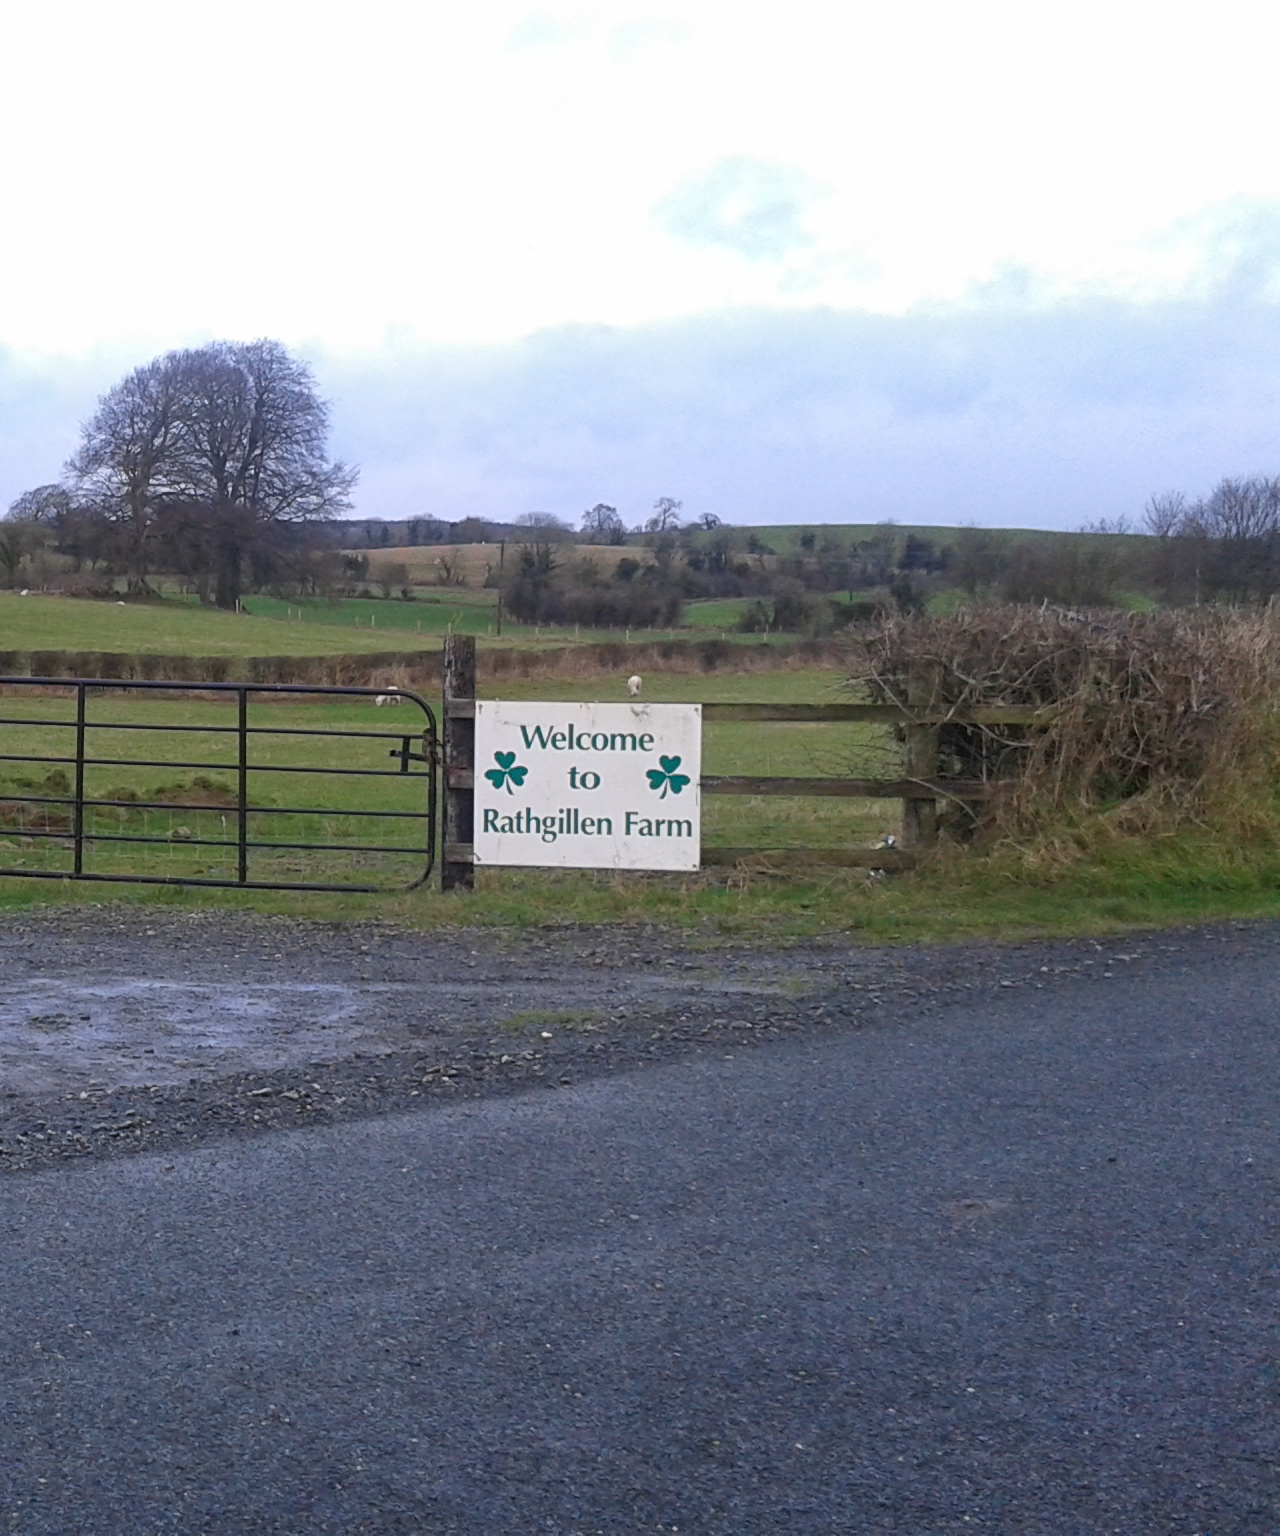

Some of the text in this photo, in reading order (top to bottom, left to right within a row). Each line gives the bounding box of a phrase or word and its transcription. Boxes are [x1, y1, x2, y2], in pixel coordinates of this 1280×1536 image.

[519, 723, 655, 752] Welcome
[566, 766, 601, 790] to
[483, 806, 693, 844] Rathgillen Farm
